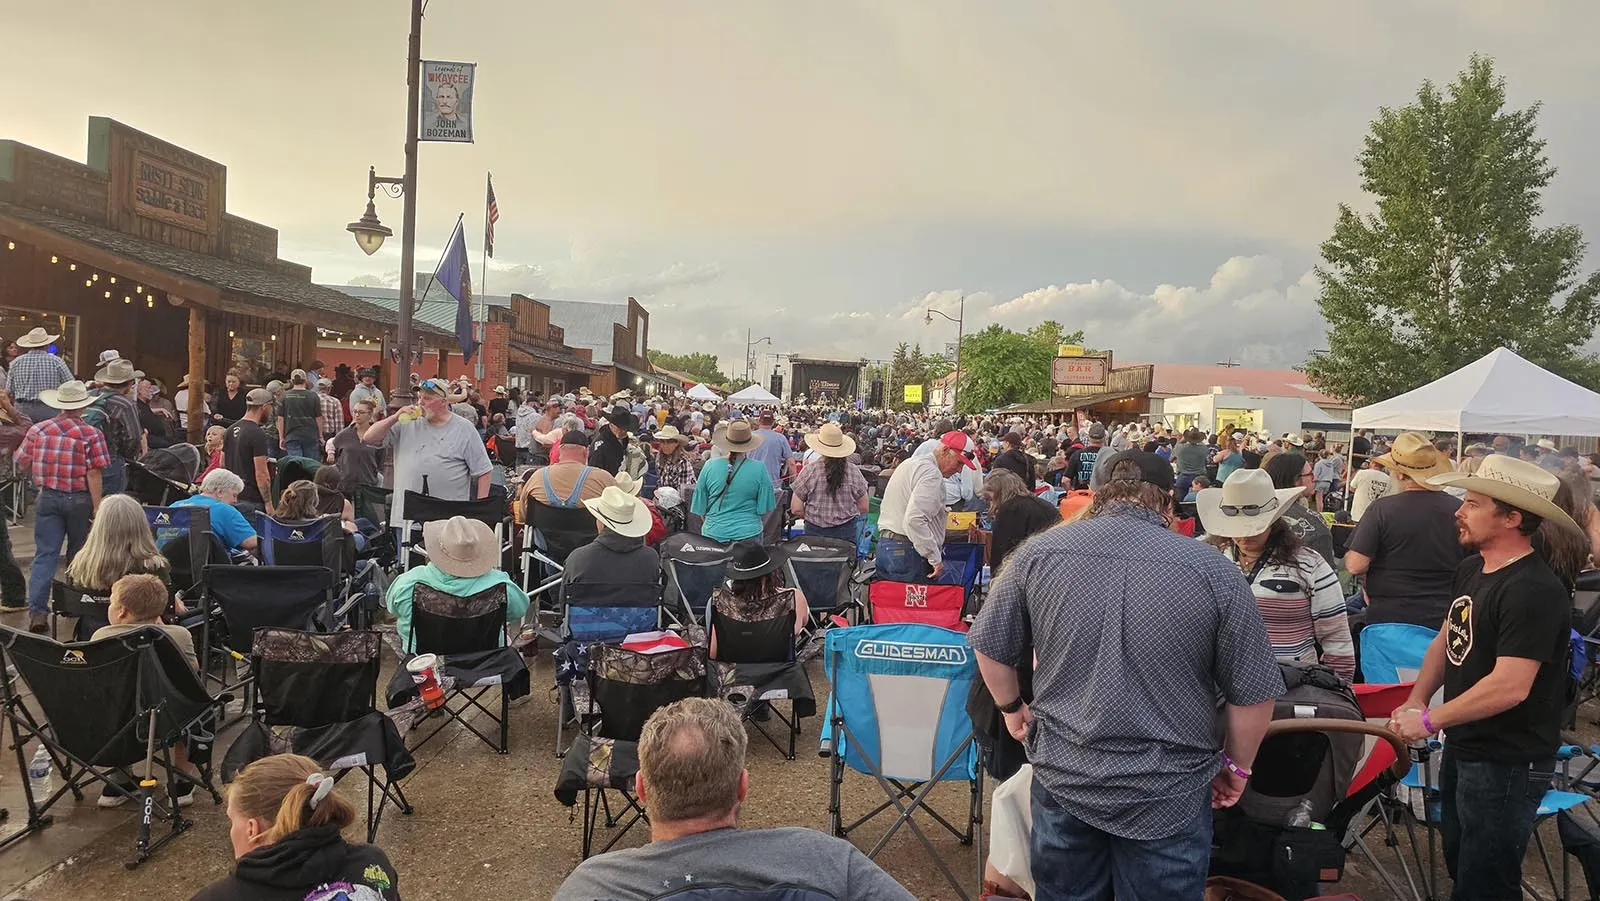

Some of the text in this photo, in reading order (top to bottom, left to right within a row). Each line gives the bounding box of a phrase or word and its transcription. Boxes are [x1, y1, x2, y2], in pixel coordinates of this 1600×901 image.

[434, 64, 456, 73] Legends
[435, 73, 469, 84] KAYCEE
[436, 119, 457, 128] JOHN
[426, 128, 467, 138] BOZEMAN
[1080, 452, 1098, 461] UNDE
[905, 585, 928, 607] N
[861, 643, 962, 661] GUIDESMAN
